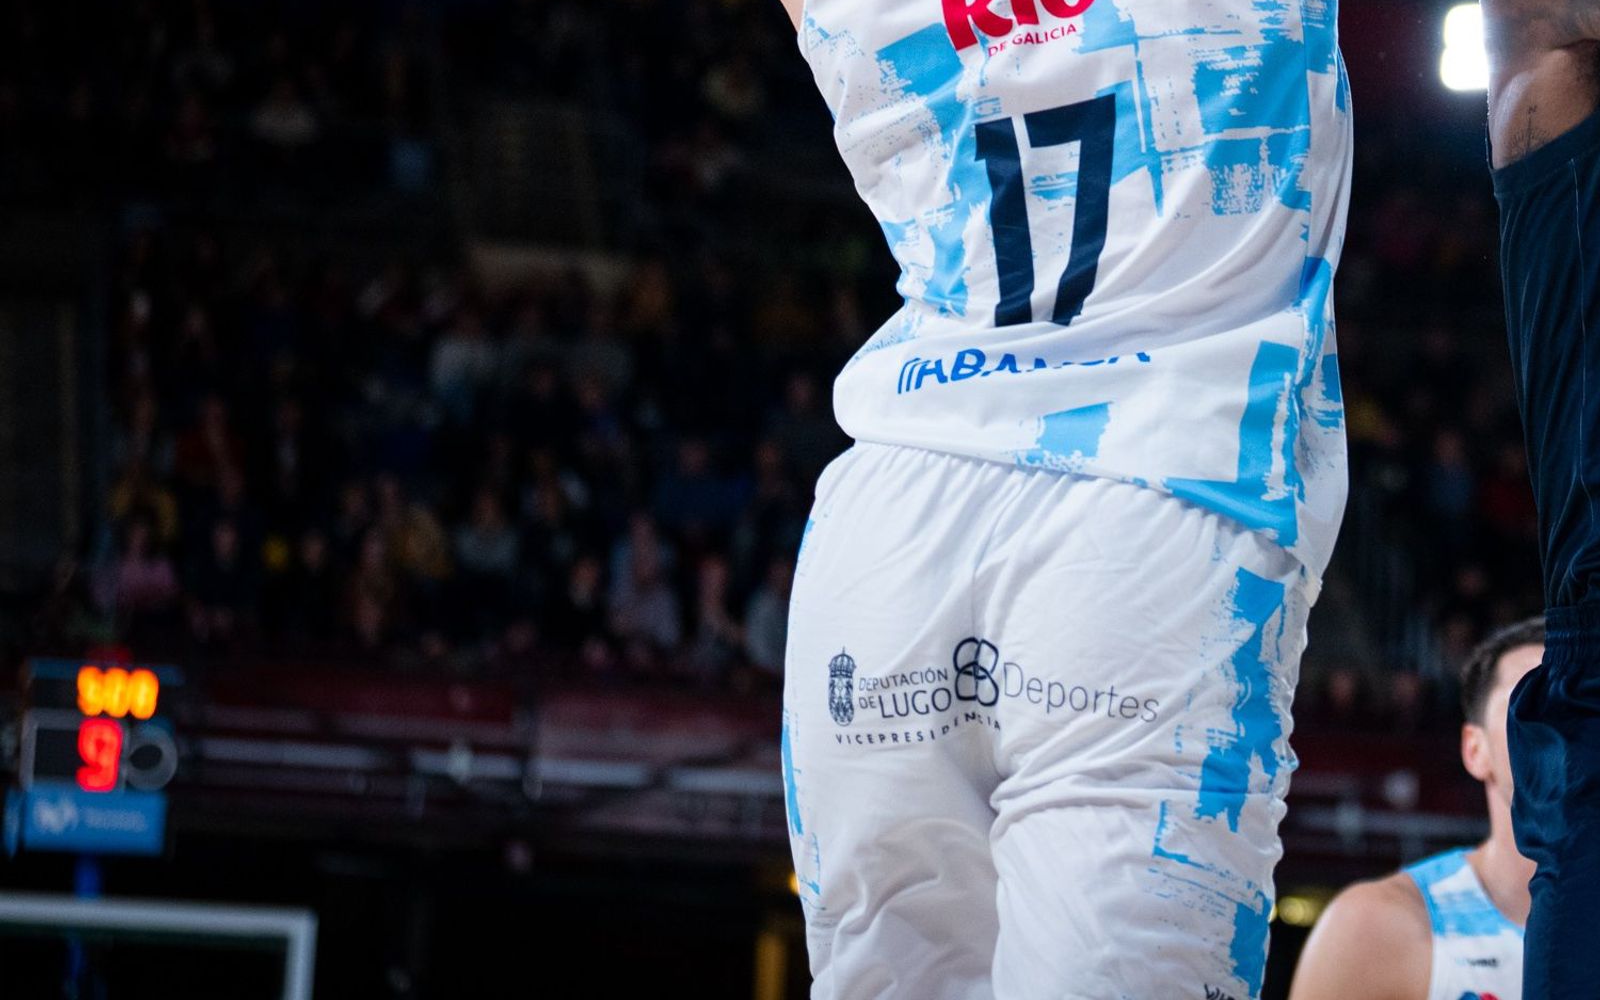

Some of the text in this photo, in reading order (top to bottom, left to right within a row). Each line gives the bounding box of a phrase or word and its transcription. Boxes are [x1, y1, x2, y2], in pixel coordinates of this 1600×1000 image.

[1012, 23, 1077, 45] GALICIA
[974, 92, 1117, 328] 17
[857, 667, 949, 692] DEPUTACIÓN
[1002, 661, 1160, 723] Deportes
[858, 686, 952, 719] DE LUGO
